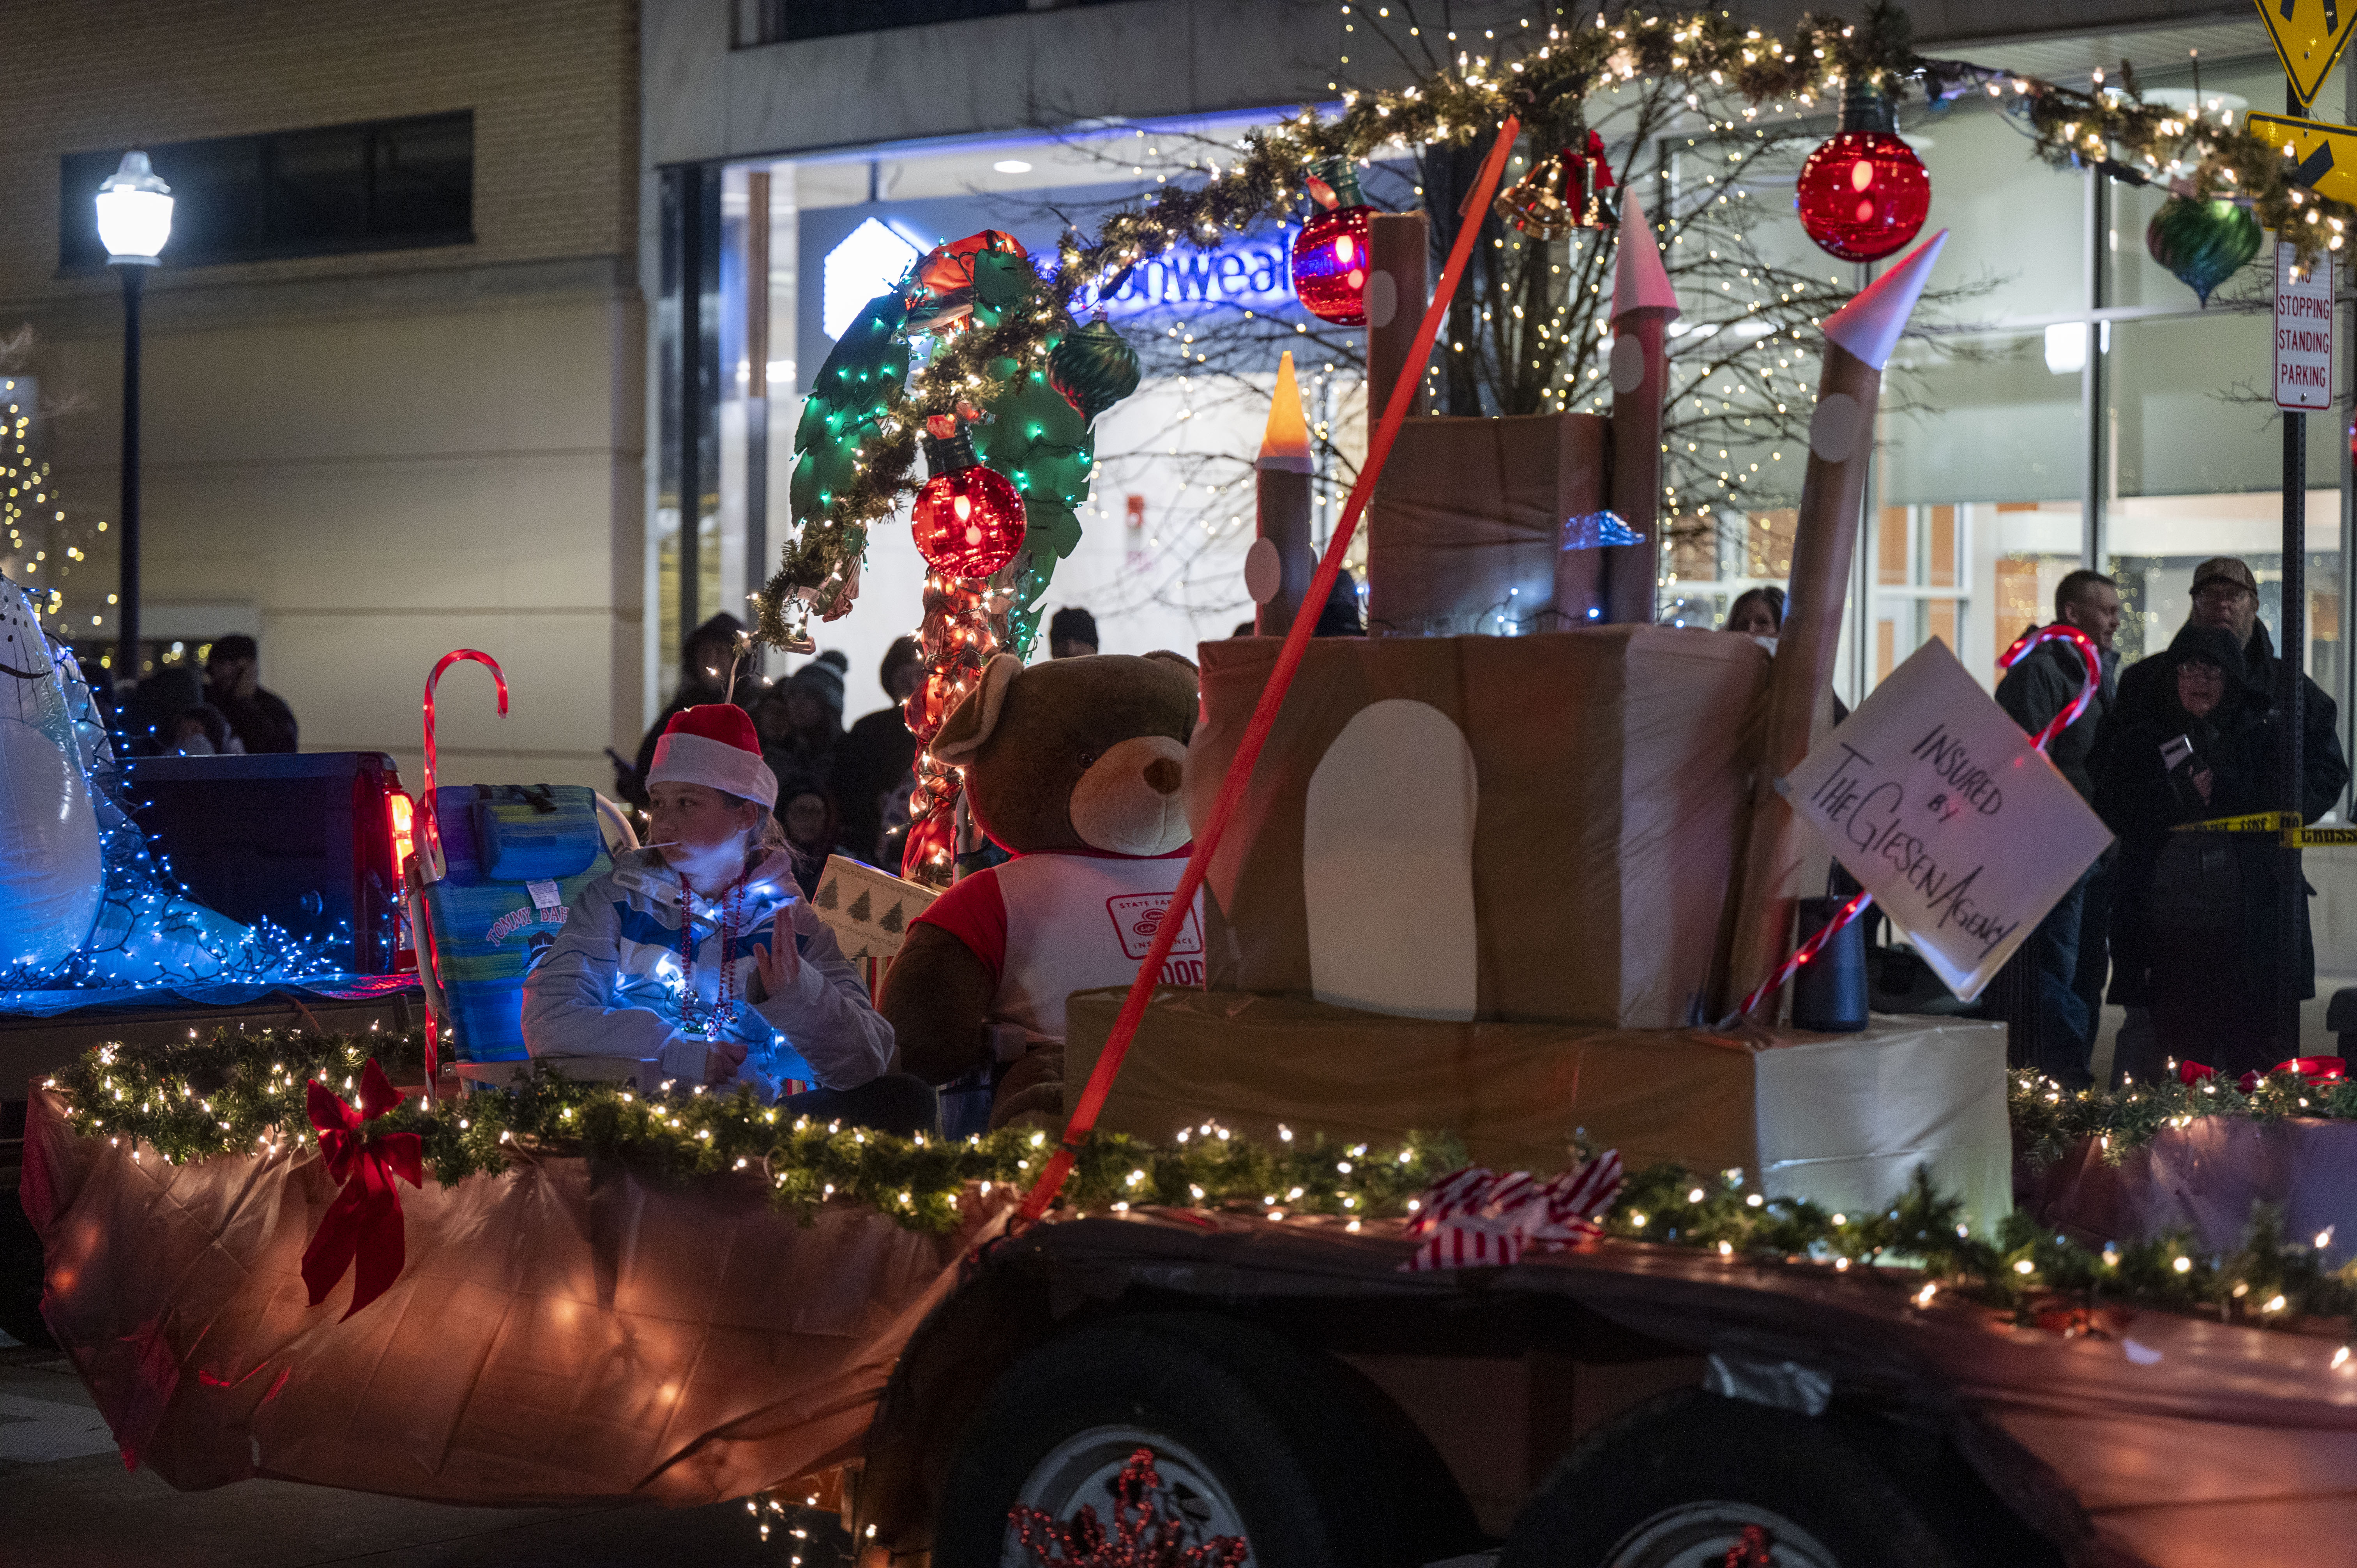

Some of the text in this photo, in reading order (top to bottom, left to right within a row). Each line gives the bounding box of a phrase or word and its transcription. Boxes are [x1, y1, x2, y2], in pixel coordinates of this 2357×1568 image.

[2279, 295, 2330, 320] STOPPING
[2279, 329, 2329, 354] STANDING
[2281, 363, 2326, 388] PARKING
[1911, 724, 2004, 816] INSURED
[1927, 795, 1959, 823] BY
[1119, 901, 1149, 909] STATE
[486, 906, 570, 947] TOMMY BAH
